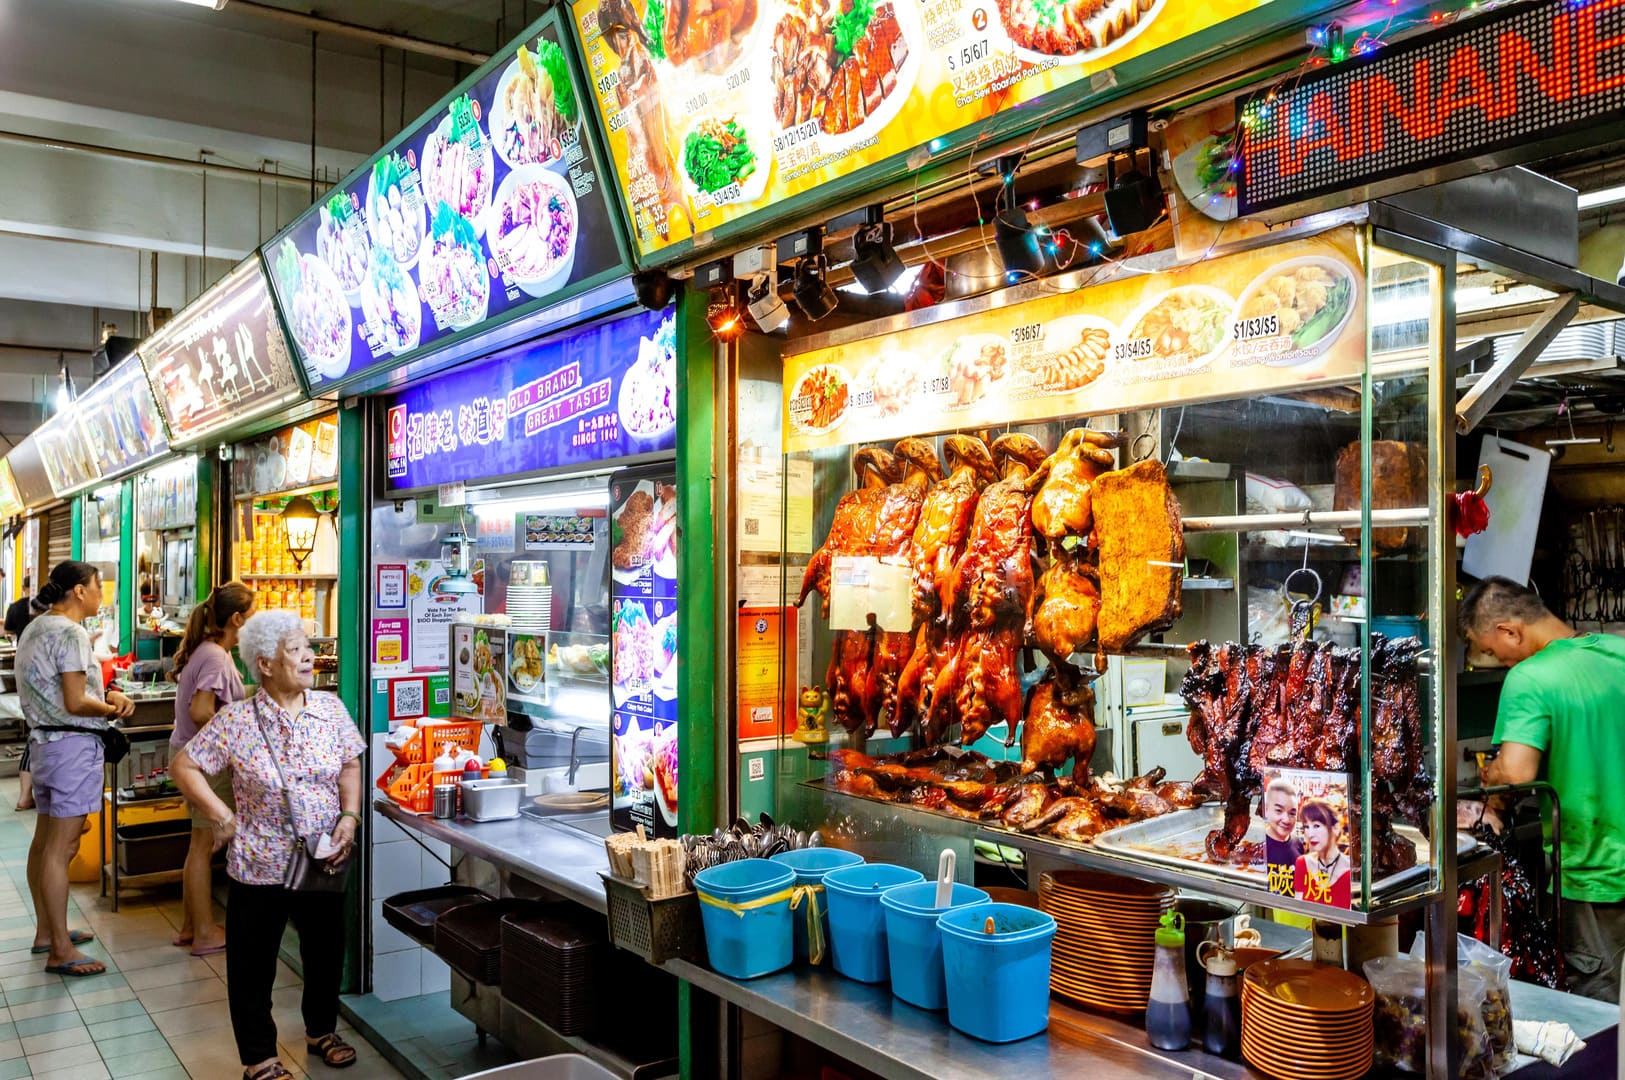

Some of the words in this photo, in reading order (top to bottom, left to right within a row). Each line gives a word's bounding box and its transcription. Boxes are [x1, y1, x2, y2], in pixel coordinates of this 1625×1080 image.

[725, 68, 750, 90] $20.00
[991, 72, 1022, 95] Roasted
[1022, 65, 1041, 81] Pork
[1041, 56, 1060, 71] Rice
[685, 92, 708, 113] $10.00
[774, 121, 818, 152] $8/12/15/20
[713, 184, 741, 206] $3/4/5/6
[636, 207, 653, 229] BLK
[652, 204, 666, 222] 32
[1010, 323, 1042, 342] 5/$6/$7
[1233, 315, 1277, 340] $1/$3/$5
[1114, 338, 1151, 359] $3/$4/$5
[509, 393, 531, 411] OLD
[537, 369, 577, 401] BRAND
[527, 403, 562, 430] GREAT
[568, 382, 610, 414] TASTE
[572, 431, 597, 447] SINCE
